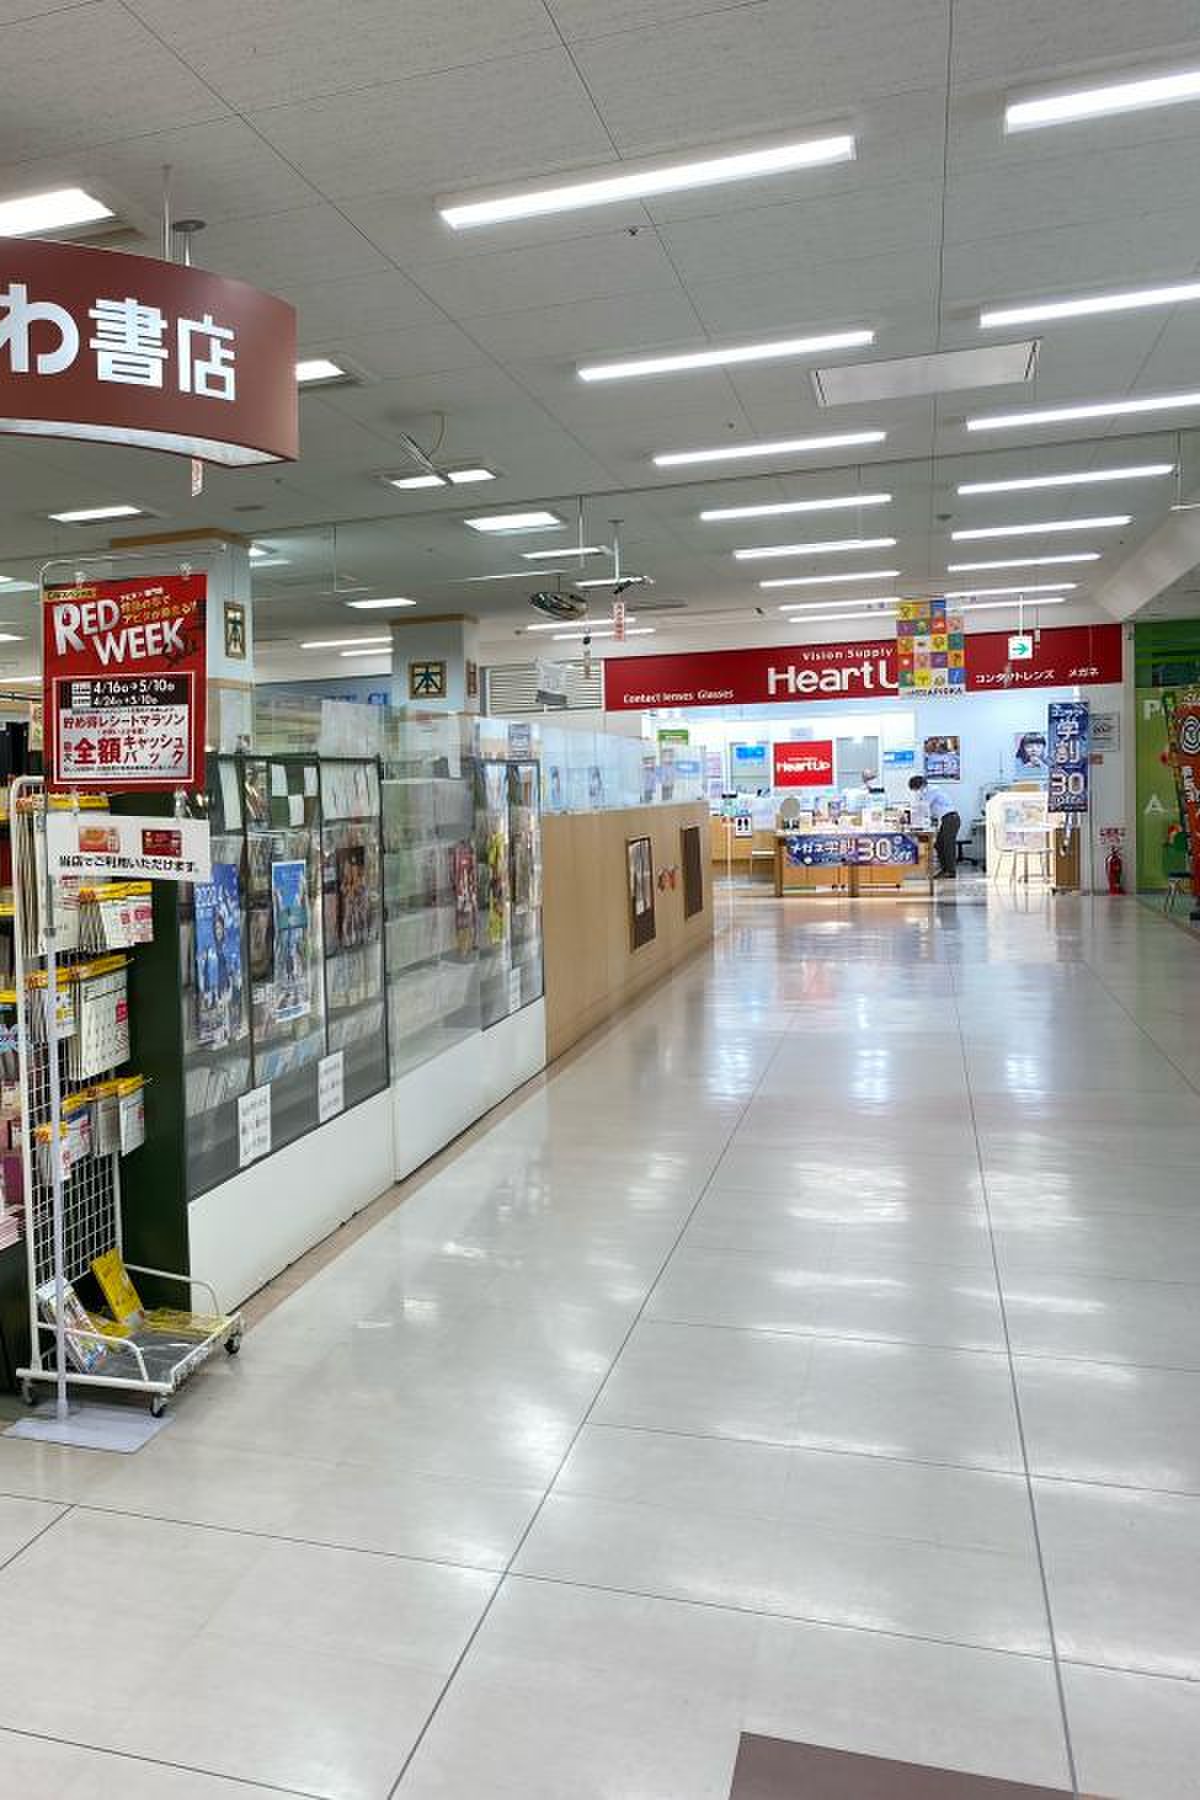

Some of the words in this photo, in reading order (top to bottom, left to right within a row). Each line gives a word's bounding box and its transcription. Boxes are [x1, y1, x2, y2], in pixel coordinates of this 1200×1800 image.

[53, 599, 121, 655] RED
[93, 617, 185, 666] WEEK
[802, 651, 844, 662] Vision
[847, 647, 894, 660] Supply
[74, 737, 121, 764] 全額
[59, 855, 199, 873] 当店でご利用いただけます。
